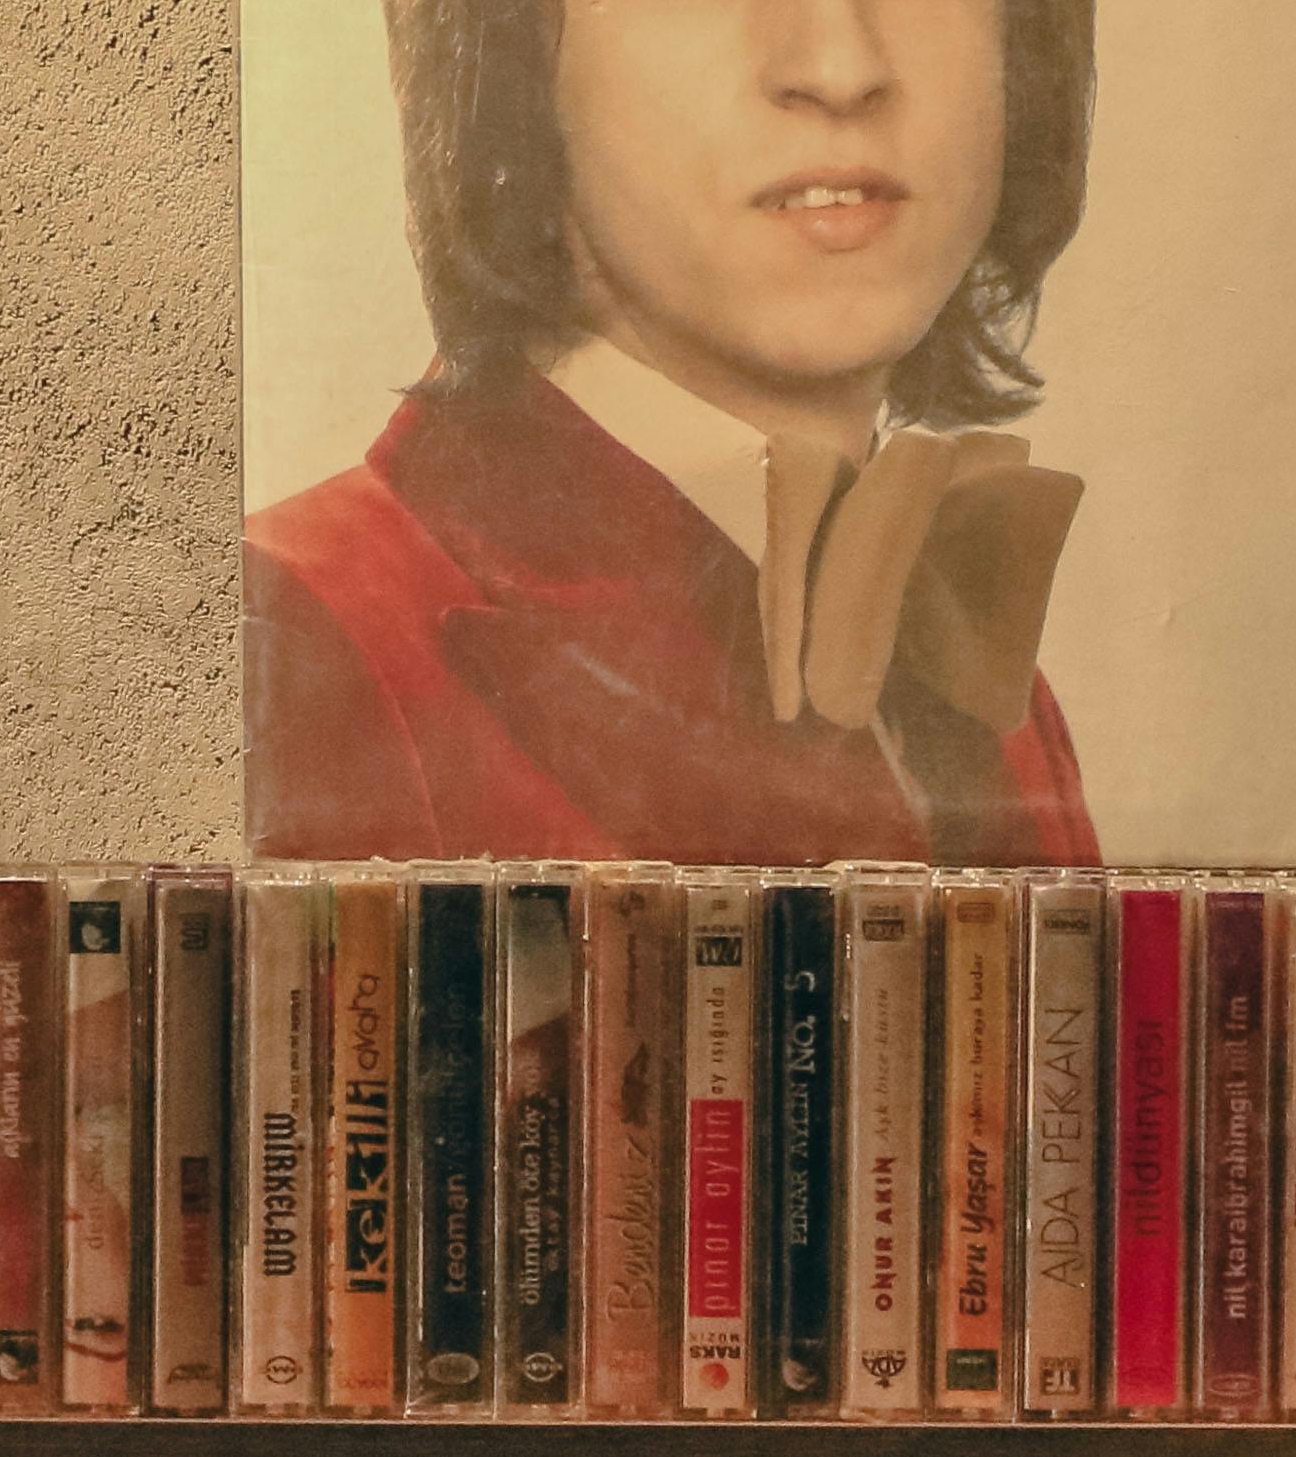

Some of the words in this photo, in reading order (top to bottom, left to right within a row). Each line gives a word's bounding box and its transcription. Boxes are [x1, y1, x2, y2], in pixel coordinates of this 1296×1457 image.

[784, 970, 816, 993] 5
[967, 953, 986, 1002] kadar
[348, 974, 381, 1072] avara
[969, 1007, 987, 1066] buraya
[710, 1074, 728, 1095] ay
[519, 1105, 547, 1148] köy
[518, 1153, 542, 1192] öte
[788, 1169, 810, 1245] PINAR
[956, 1143, 994, 1235] Yaşar
[1224, 1080, 1251, 1279] karaibrahimgil
[443, 1173, 467, 1294] teoman
[519, 1197, 543, 1306] ölümden
[603, 1135, 657, 1325] Bendeniz
[1039, 1186, 1085, 1290] AJDA
[867, 1237, 901, 1312] ONUR
[956, 1245, 988, 1317] Ebru
[1224, 1283, 1249, 1320] nil
[689, 1346, 741, 1359] RAKS
